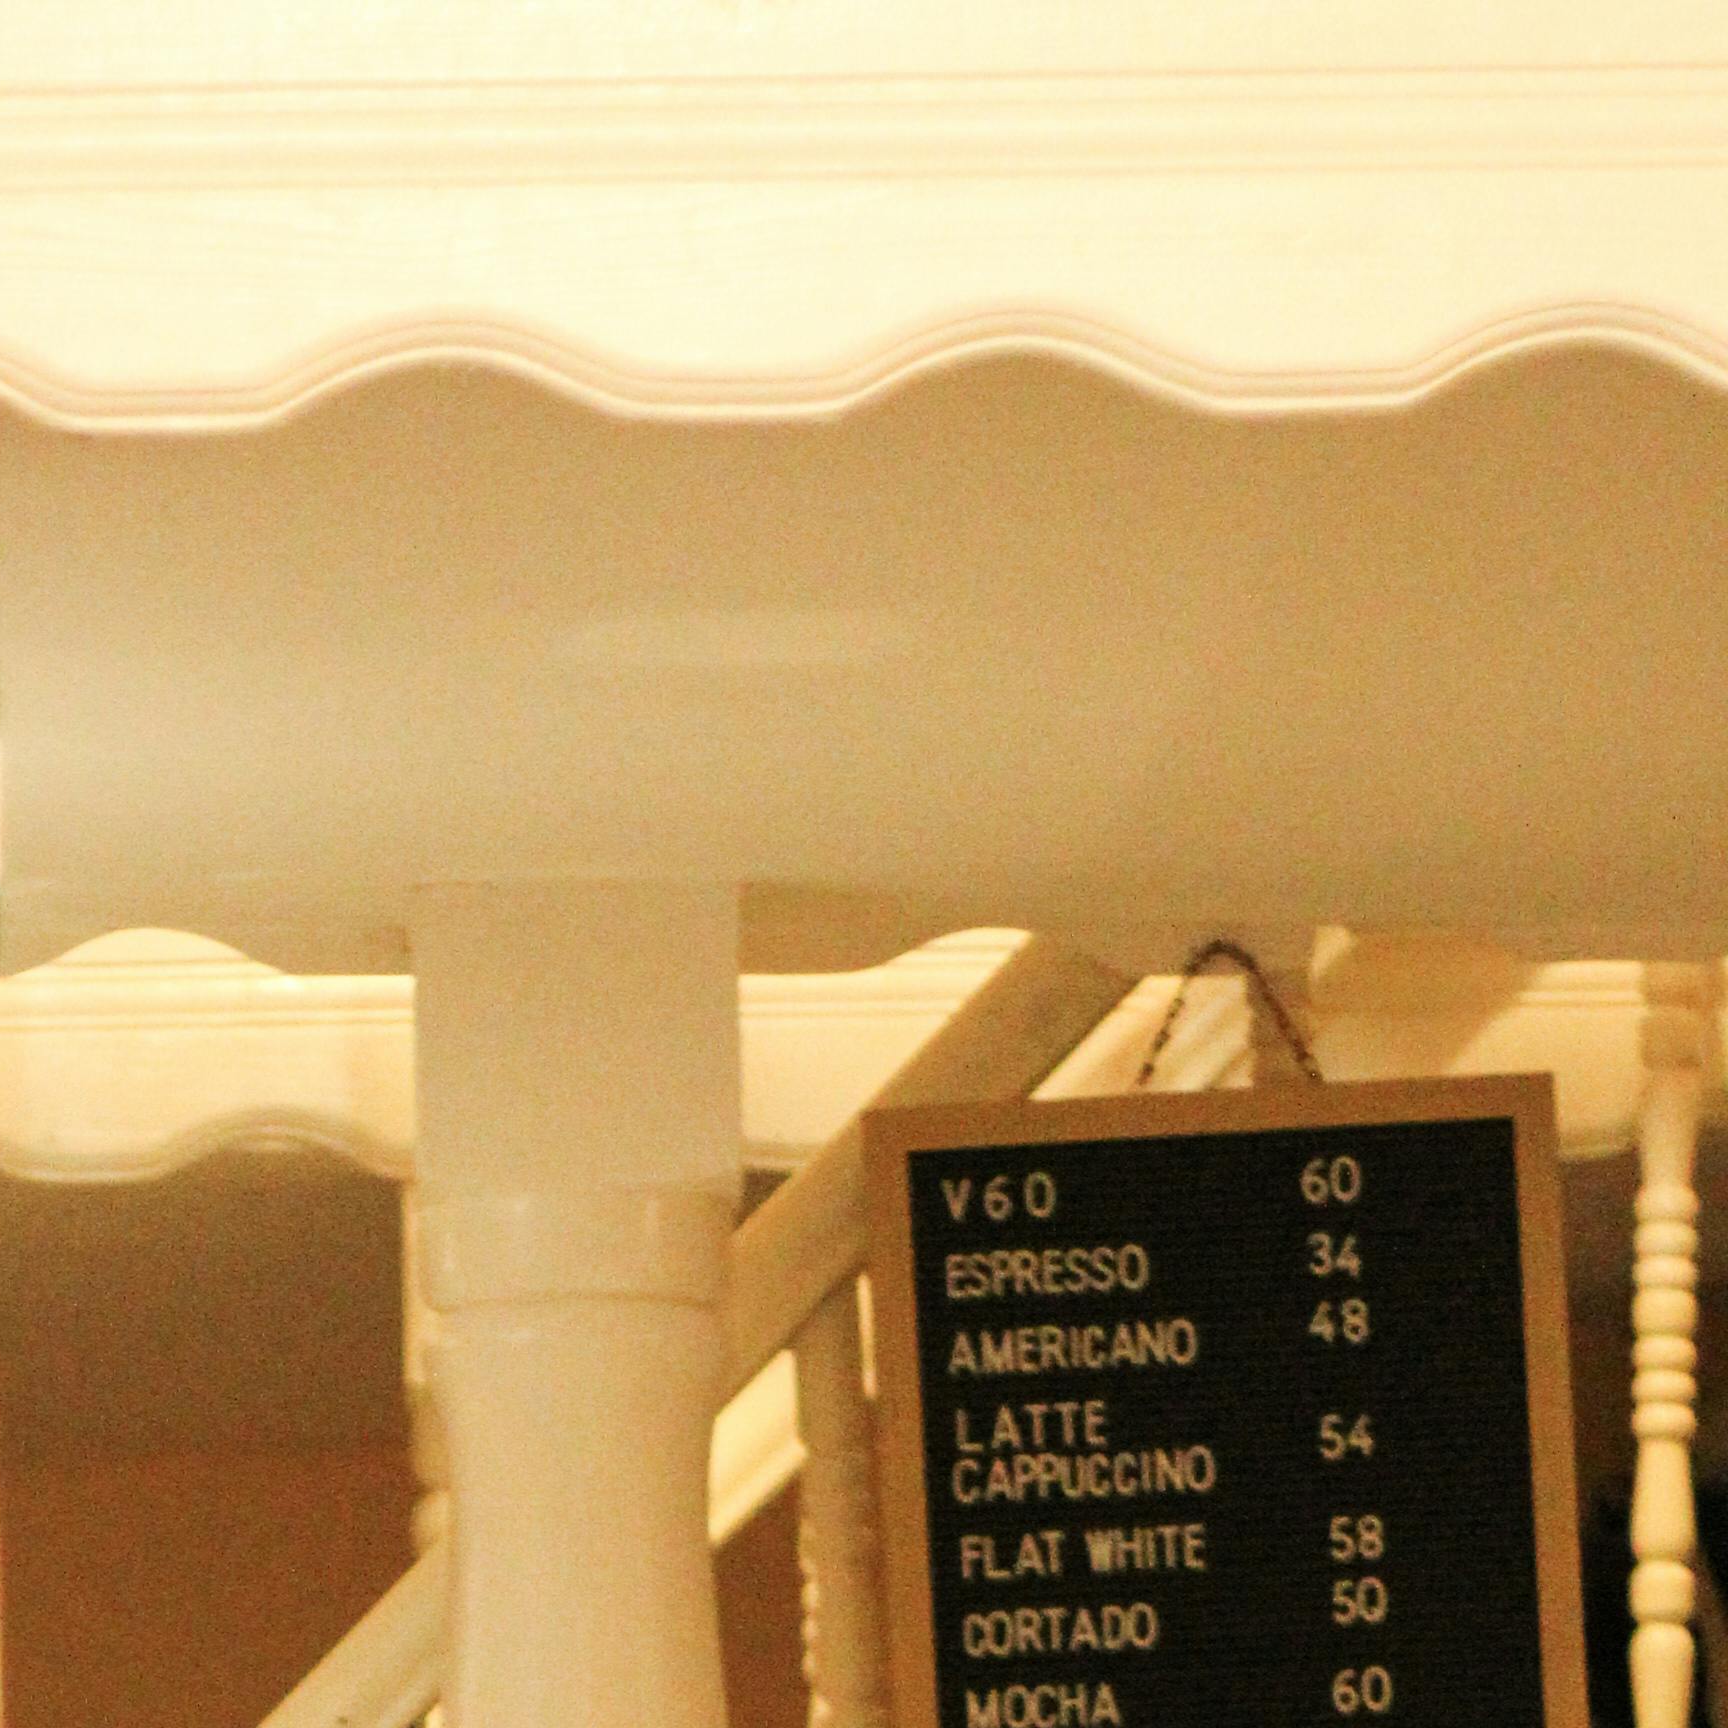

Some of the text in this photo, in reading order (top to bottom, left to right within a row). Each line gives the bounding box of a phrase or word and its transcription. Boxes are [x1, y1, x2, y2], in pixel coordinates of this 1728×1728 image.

[1299, 1155, 1362, 1204] 60
[944, 1232, 1362, 1299] ESPRESSO 34
[948, 1298, 1371, 1376] AMERICANO 48
[952, 1413, 1375, 1504] CAPPUCCINO 54
[954, 1400, 1107, 1454] LATTE
[960, 1515, 1385, 1581] FLAT WHITE 58
[962, 1575, 1389, 1659] CORTADO 50
[1331, 1665, 1393, 1715] 60
